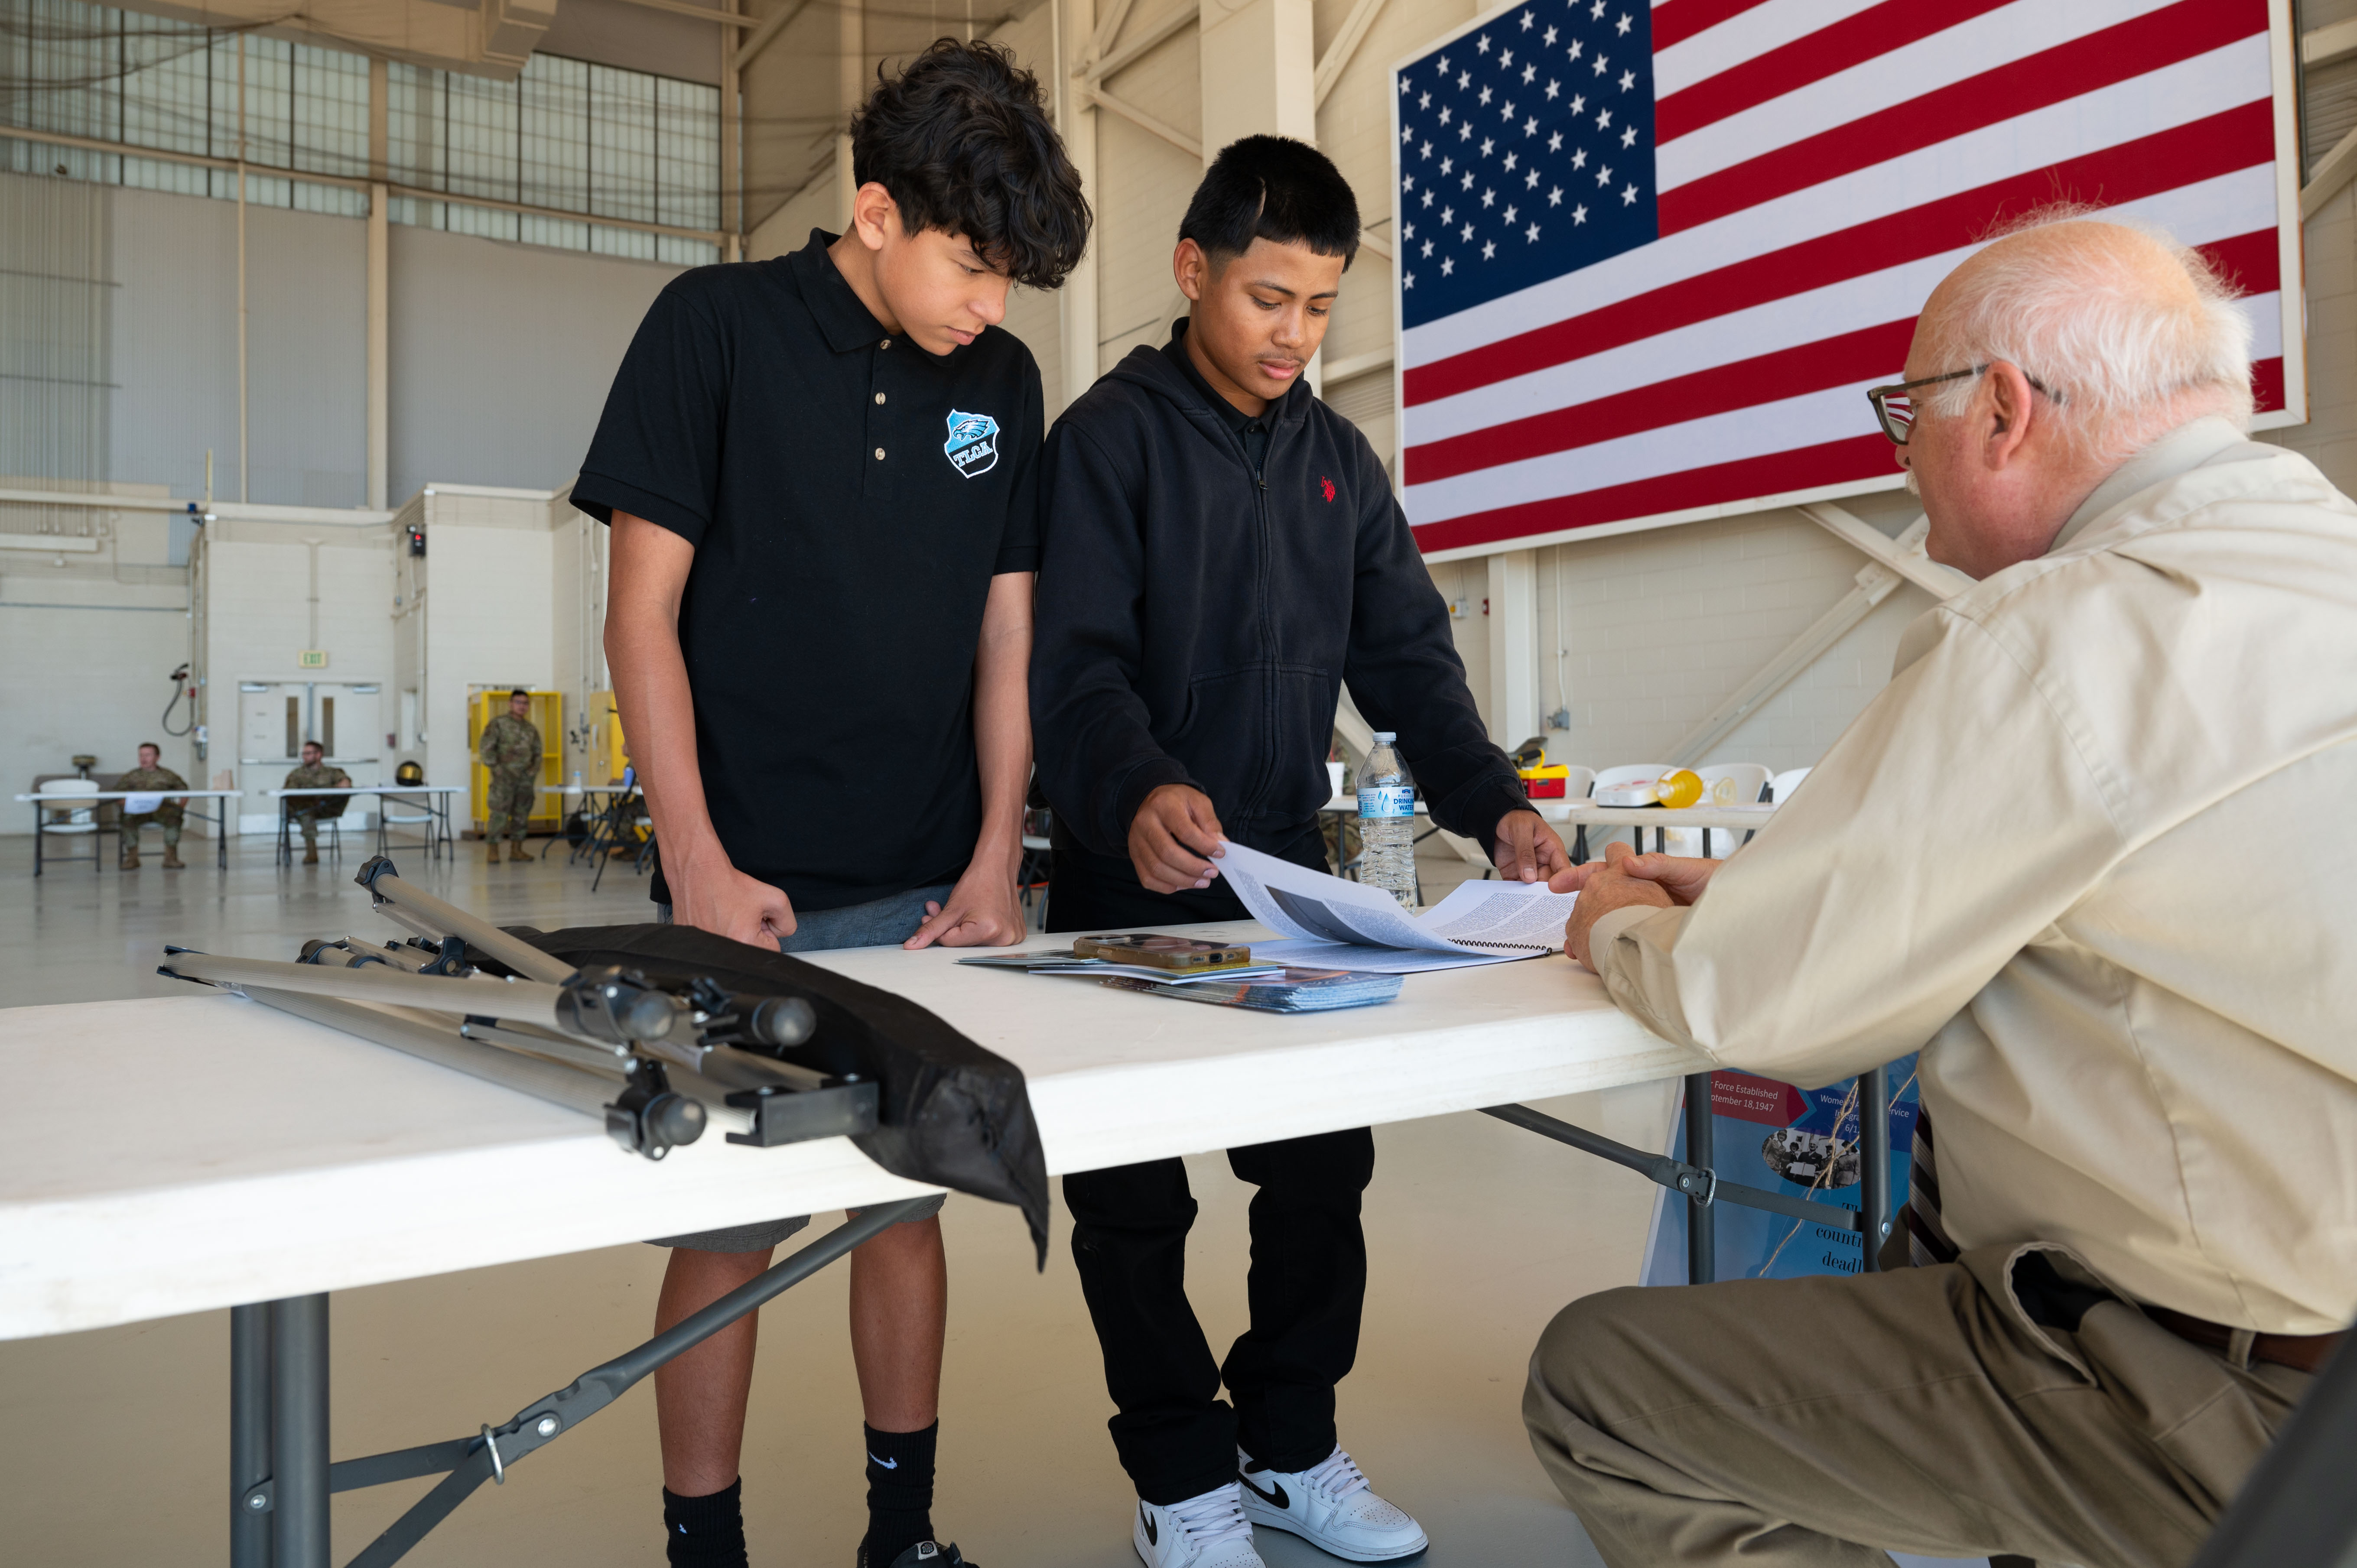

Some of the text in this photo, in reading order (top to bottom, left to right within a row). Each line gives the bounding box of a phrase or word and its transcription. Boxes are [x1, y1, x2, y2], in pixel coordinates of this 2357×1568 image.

[953, 441, 993, 467] TLCA
[303, 653, 321, 664] EXIT
[1714, 1081, 1778, 1100] Force Established
[1711, 1095, 1774, 1112] ptember 18,1947
[1888, 1108, 1909, 1118] ervice
[1816, 1227, 1862, 1248] countr
[1822, 1251, 1862, 1274] deadl
